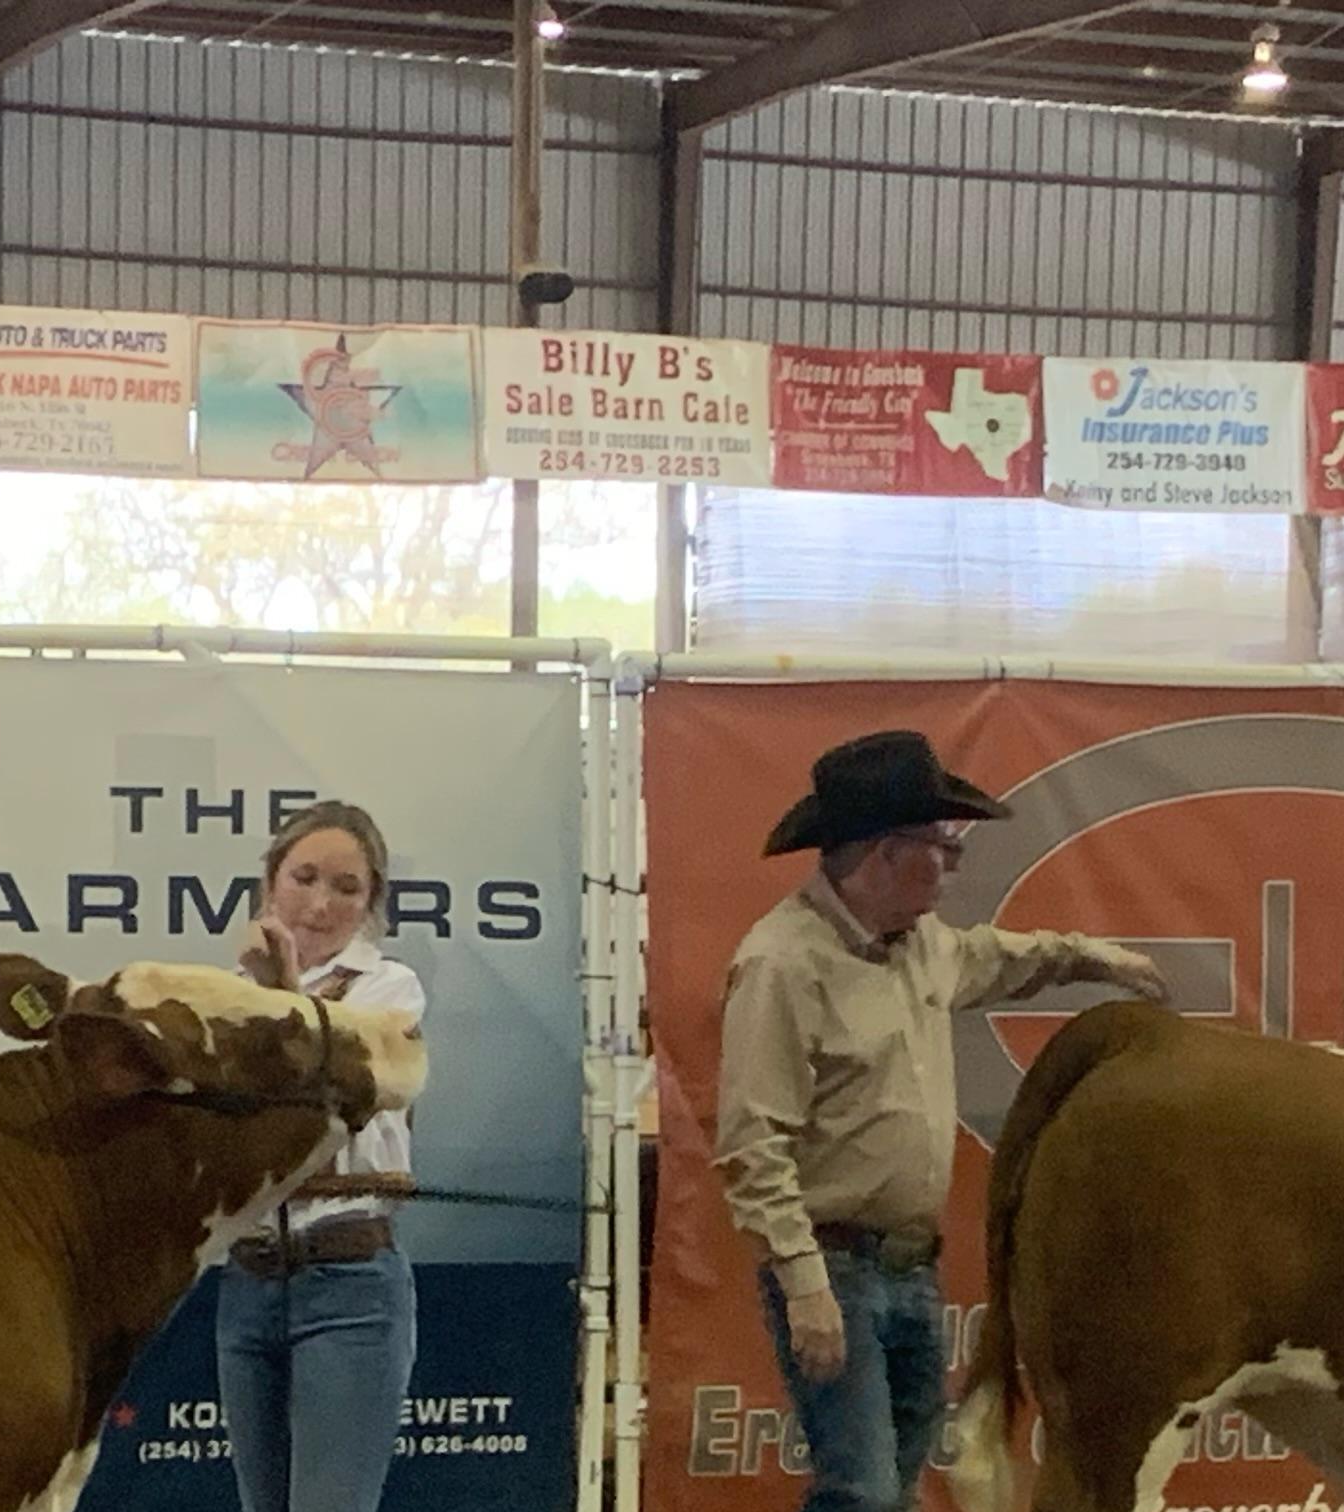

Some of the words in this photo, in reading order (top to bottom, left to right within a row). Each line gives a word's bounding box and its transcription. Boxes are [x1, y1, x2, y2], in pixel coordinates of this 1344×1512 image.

[30, 326, 44, 348] &
[49, 327, 108, 349] TRUCK
[111, 331, 168, 354] PARTS
[541, 339, 635, 386] Billy
[658, 346, 714, 382] B's
[10, 374, 62, 397] NAPA
[67, 375, 118, 401] AUTO
[123, 380, 183, 405] PARTS
[505, 384, 574, 416] Sale
[591, 388, 665, 422] Barn
[1105, 367, 1258, 418] Jackson's
[1081, 417, 1212, 446] Insurance
[1215, 419, 1269, 446] Plus
[1120, 482, 1157, 504] and
[1163, 482, 1213, 504] Steve
[1220, 483, 1293, 505] Jackson
[109, 786, 318, 836] THE
[168, 1401, 228, 1430] KO
[139, 1441, 200, 1464] (254)
